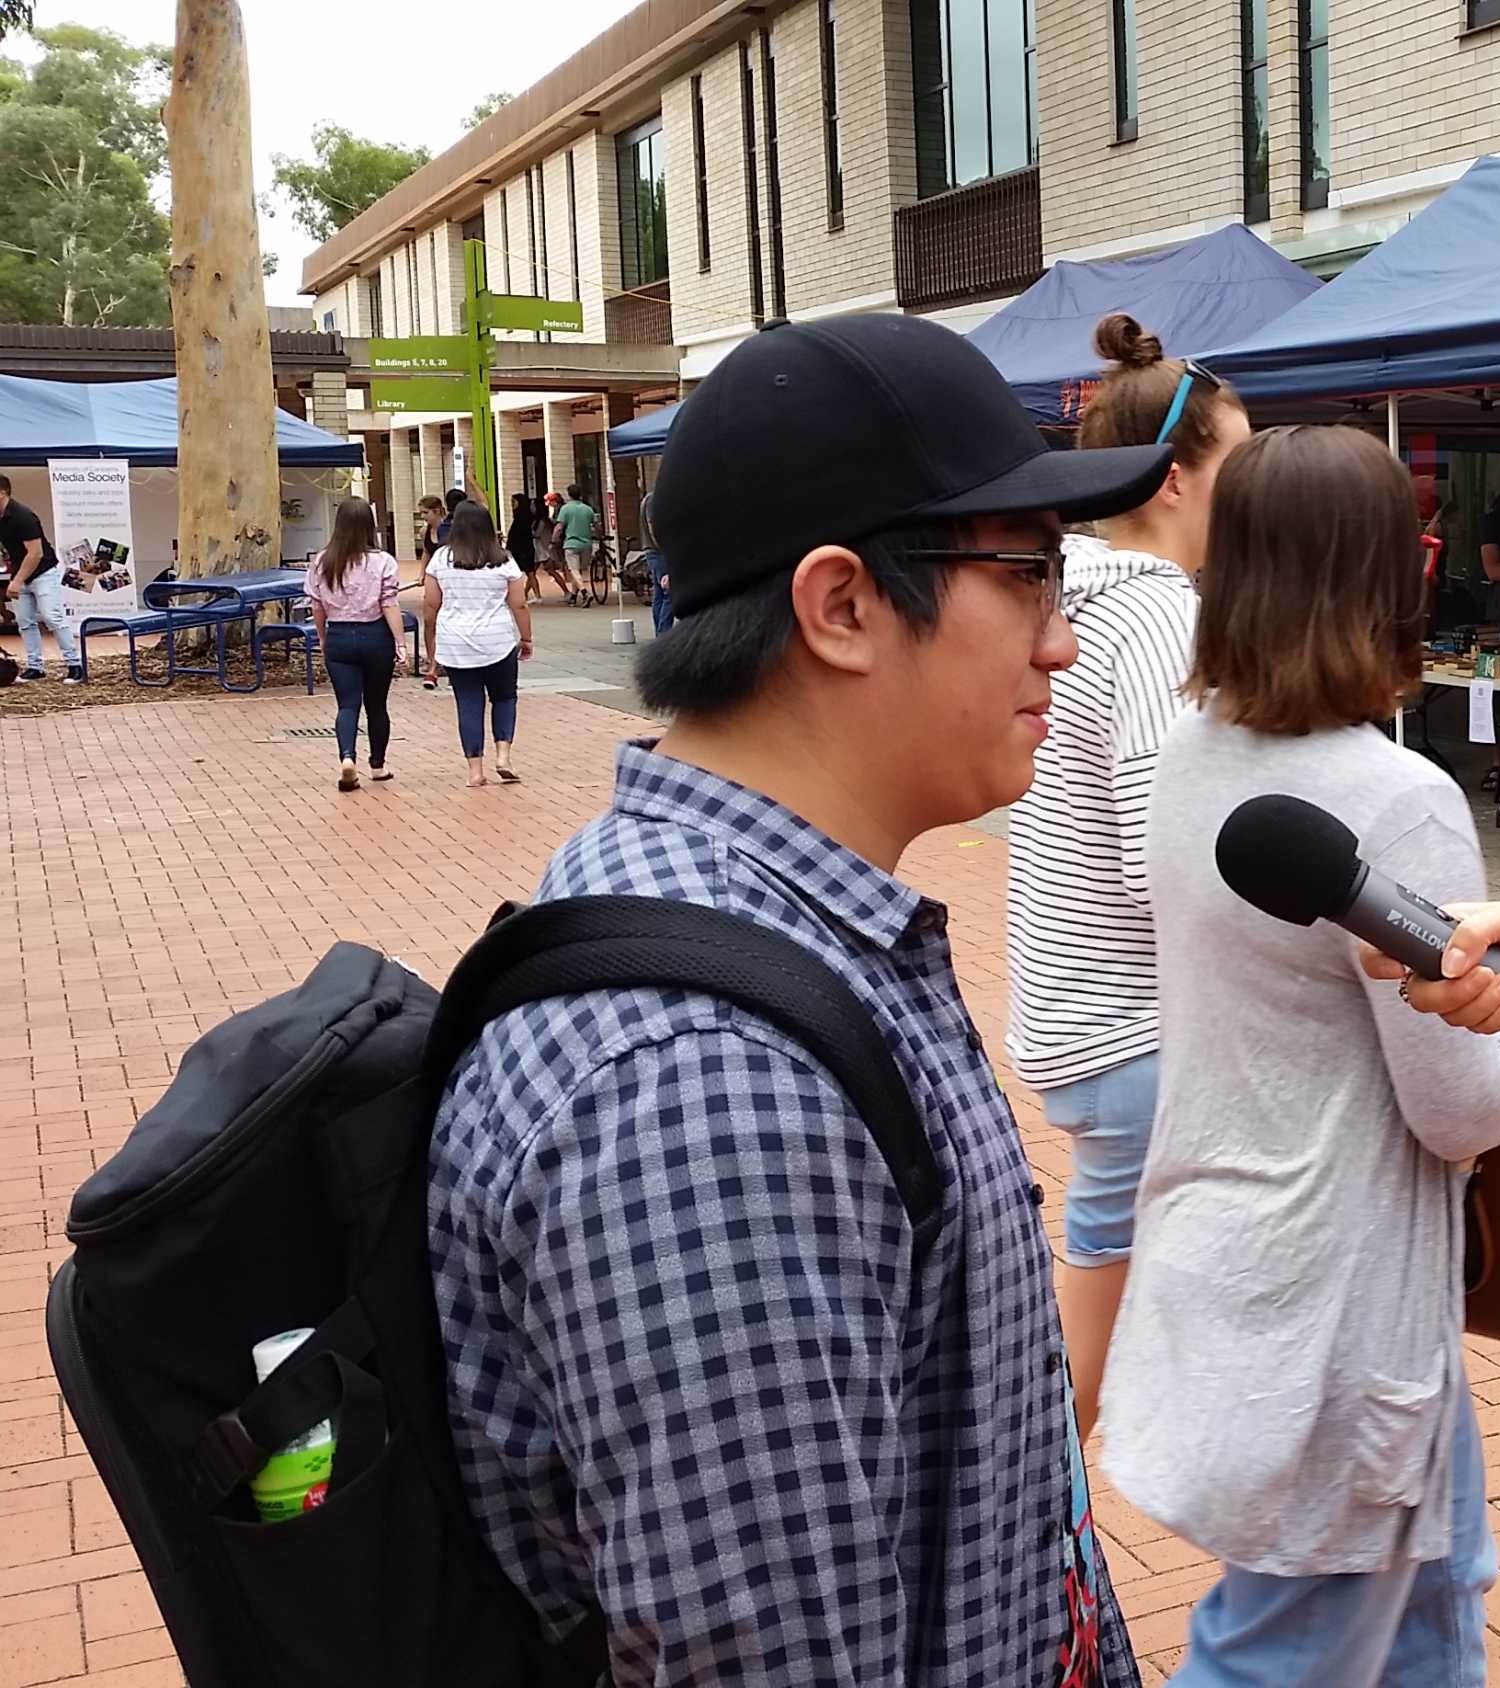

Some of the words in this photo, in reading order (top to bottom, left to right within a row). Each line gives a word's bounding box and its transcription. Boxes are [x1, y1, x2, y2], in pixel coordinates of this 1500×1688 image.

[543, 320, 579, 329] Refectory
[375, 358, 411, 368] Buildings
[437, 358, 448, 367] 20
[377, 400, 406, 409] Library
[52, 472, 85, 482] Media
[87, 471, 126, 484] Society
